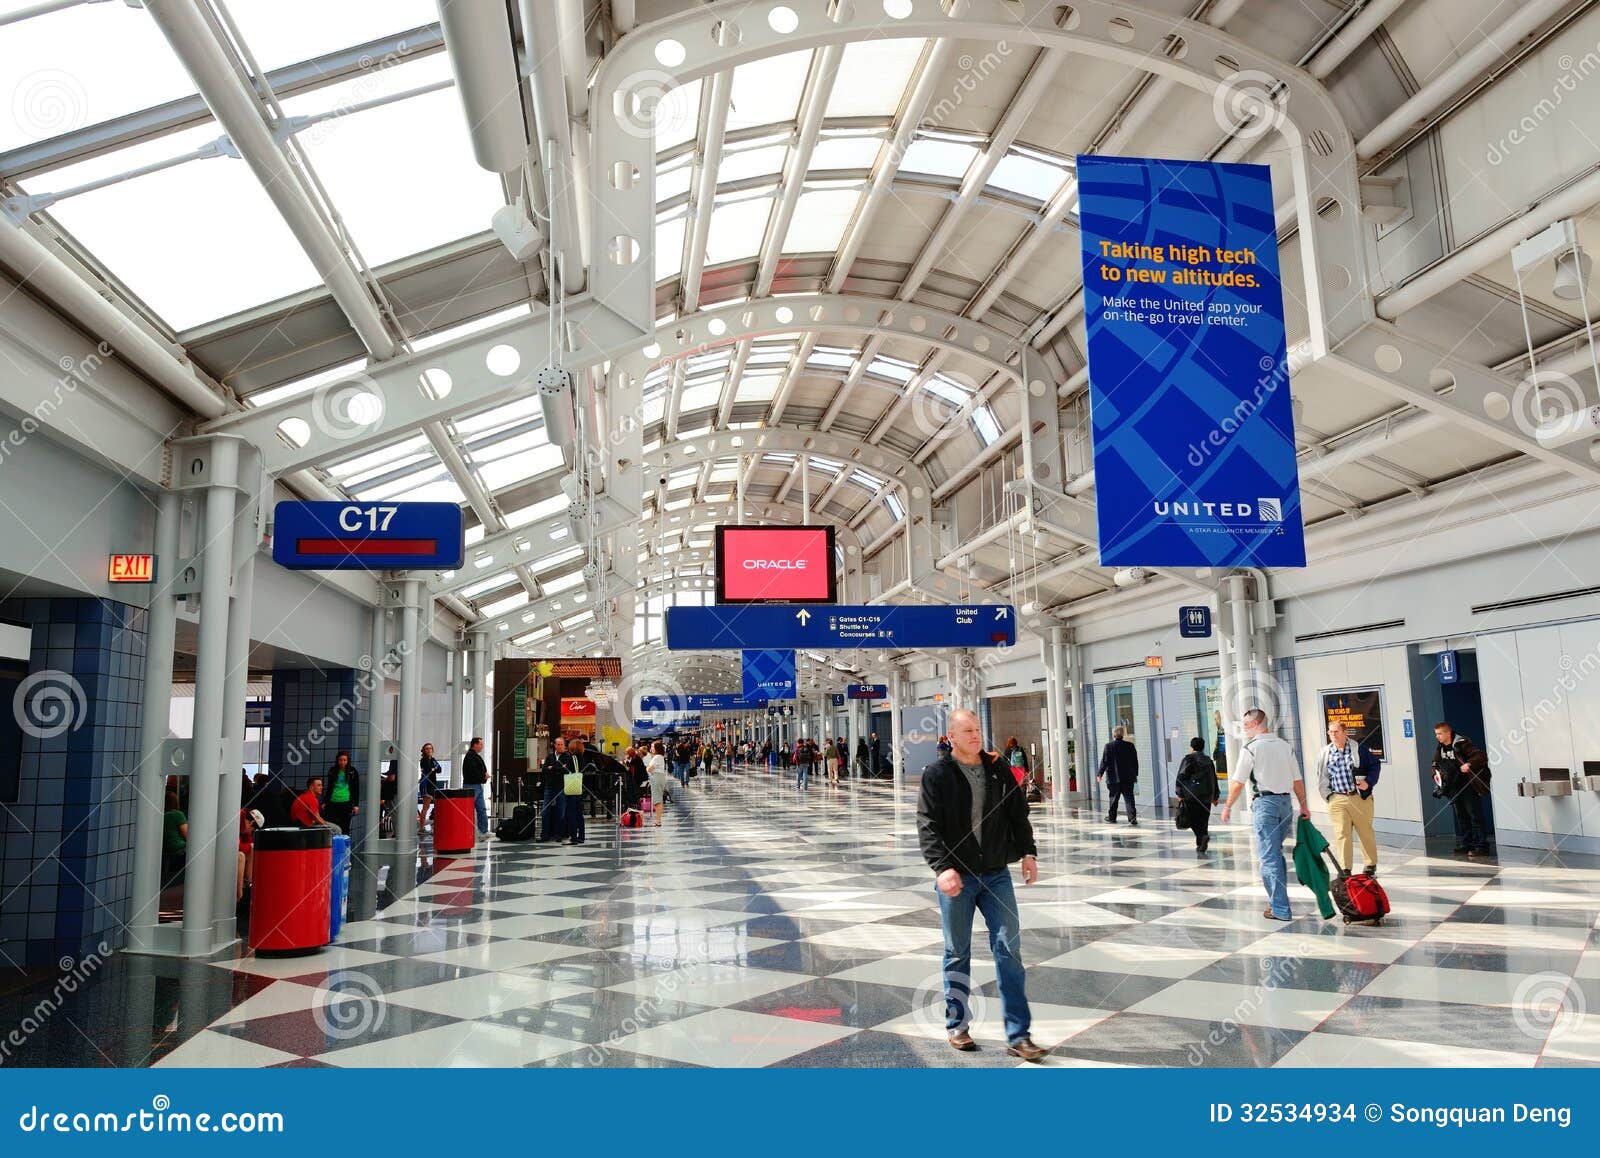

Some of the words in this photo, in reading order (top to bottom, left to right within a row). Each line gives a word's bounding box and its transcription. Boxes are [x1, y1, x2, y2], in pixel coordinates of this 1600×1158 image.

[1099, 241, 1164, 263] Taking
[1169, 244, 1211, 264] high
[1215, 247, 1256, 264] tech
[1100, 264, 1121, 281] to
[1126, 268, 1166, 284] new
[1172, 268, 1260, 288] altitudes.
[1103, 296, 1136, 309] Make
[1140, 297, 1160, 309] the
[1163, 299, 1204, 312] United
[1208, 303, 1231, 314] app
[1234, 303, 1262, 315] your
[1103, 310, 1164, 325] on-the-go
[1168, 311, 1204, 325] travel
[1207, 314, 1248, 327] center.
[1154, 501, 1252, 517] UNITED
[338, 505, 398, 532] C17
[113, 555, 151, 576] EXIT
[743, 559, 807, 569] ORACLE
[956, 608, 978, 616] United
[956, 616, 973, 624] Club
